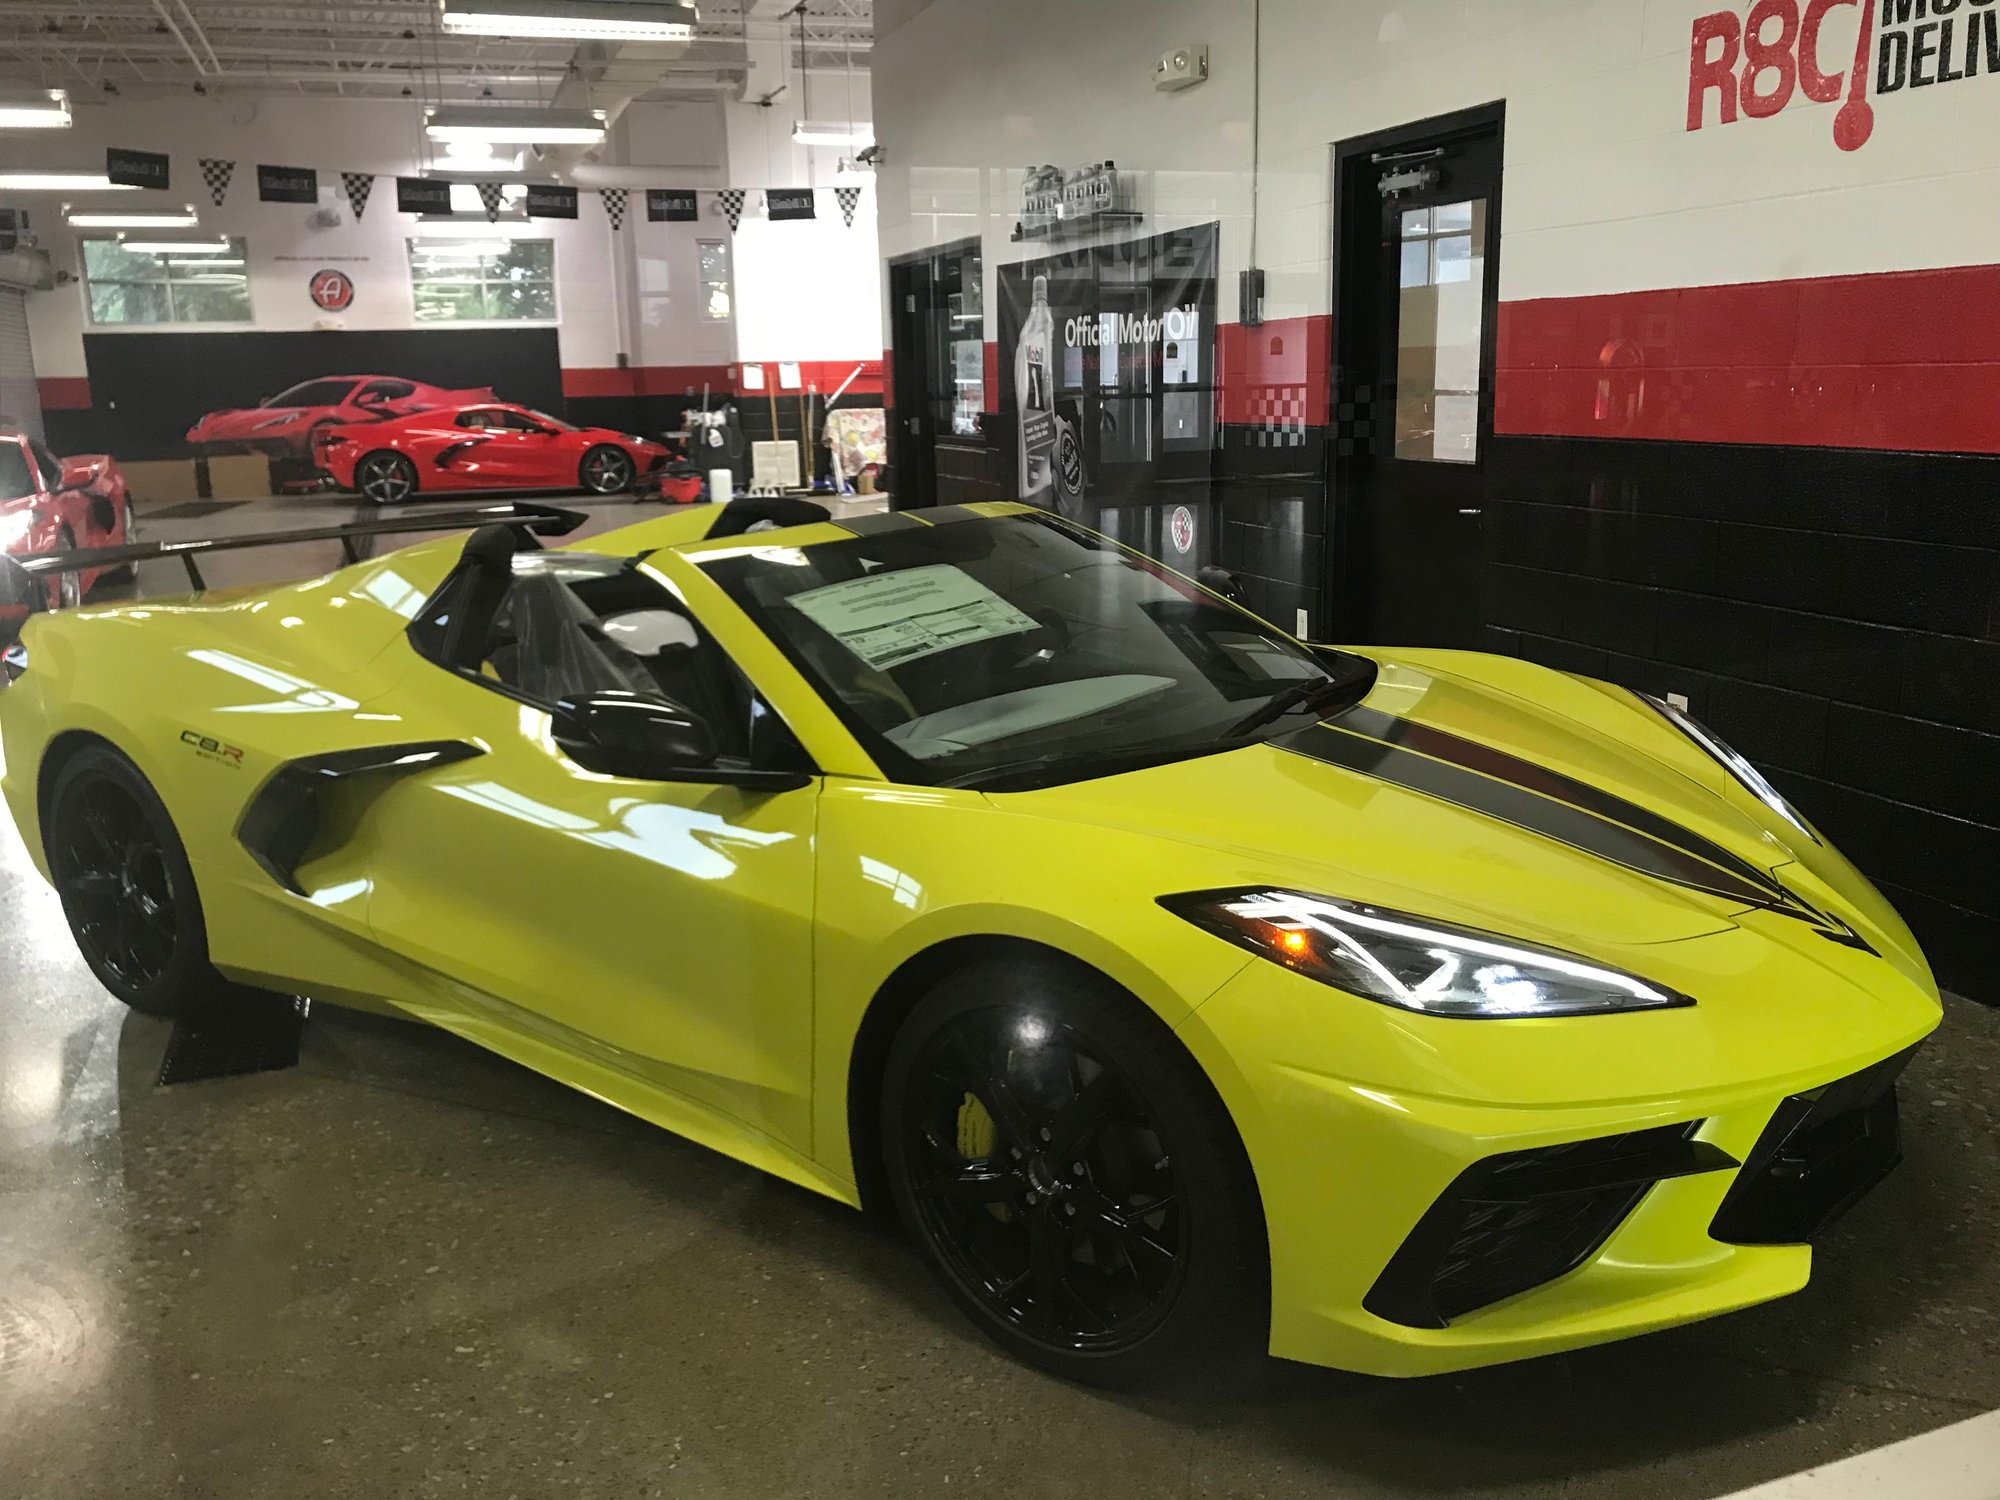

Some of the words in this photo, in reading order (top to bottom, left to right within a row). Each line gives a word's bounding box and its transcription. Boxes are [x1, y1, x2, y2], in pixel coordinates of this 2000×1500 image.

[1686, 0, 1858, 132] R8C
[1064, 313, 1114, 347] Official
[1118, 312, 1164, 344] Motor
[1167, 303, 1196, 340] Oil
[180, 730, 244, 764] C8.R
